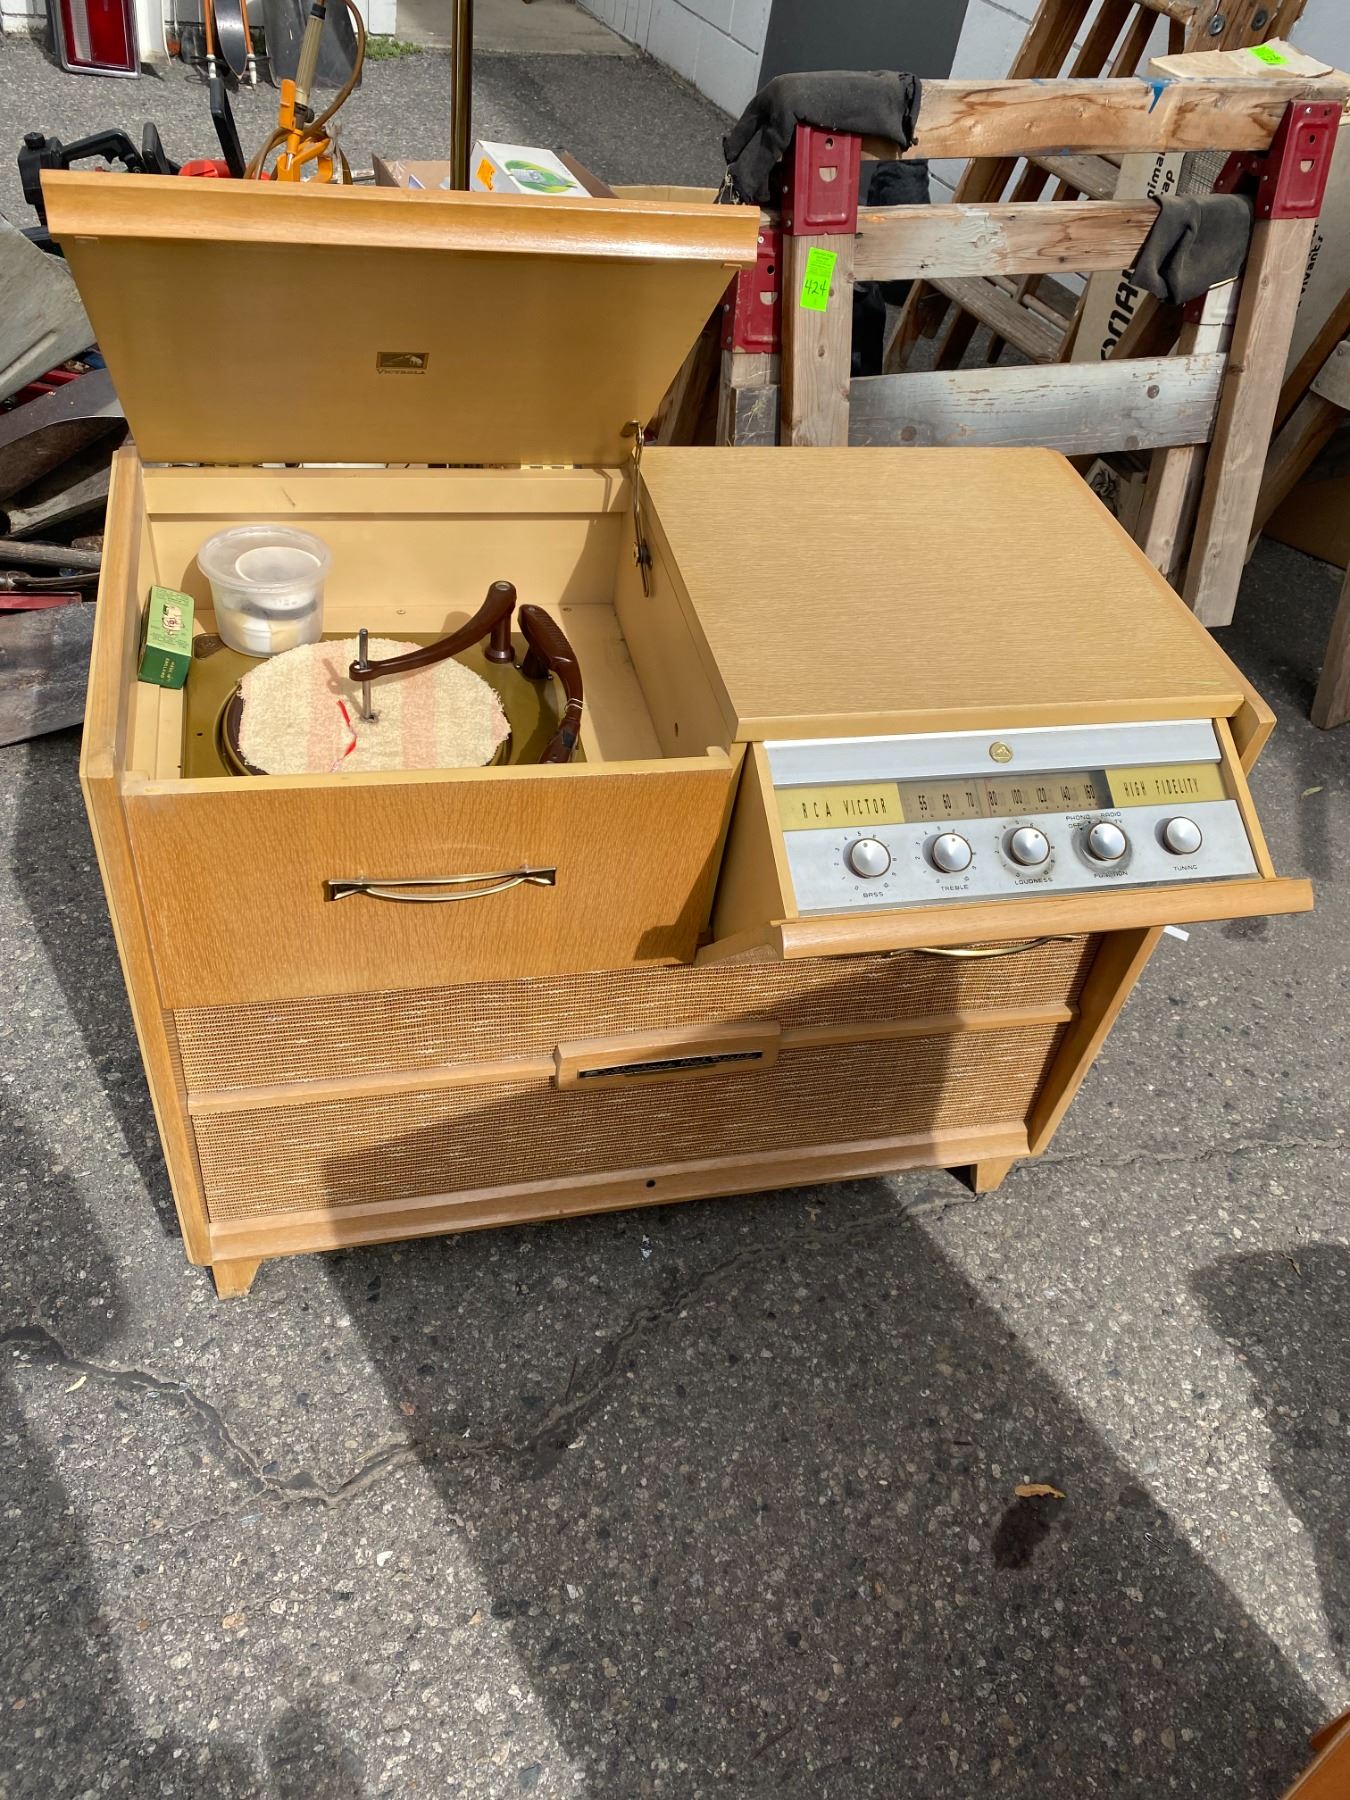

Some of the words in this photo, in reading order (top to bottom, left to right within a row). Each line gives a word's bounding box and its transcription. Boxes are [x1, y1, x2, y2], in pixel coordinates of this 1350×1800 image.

[804, 279, 828, 296] 424
[1123, 780, 1147, 797] HIGH
[1155, 777, 1199, 795] FIDELITY
[917, 794, 928, 811] 55
[942, 793, 952, 809] 60
[965, 791, 975, 808] 70
[987, 790, 998, 806] 80
[1010, 788, 1023, 804] 100
[1035, 787, 1048, 803] 120
[1059, 785, 1071, 801] 140
[1083, 784, 1096, 799] 160
[843, 797, 887, 815] VICTOR
[1065, 813, 1091, 821] PHONO
[1172, 864, 1198, 872] TUNING
[1093, 870, 1129, 879] FUNCTION
[1014, 877, 1054, 886] LOUDNESS
[940, 884, 969, 892] TREBLE
